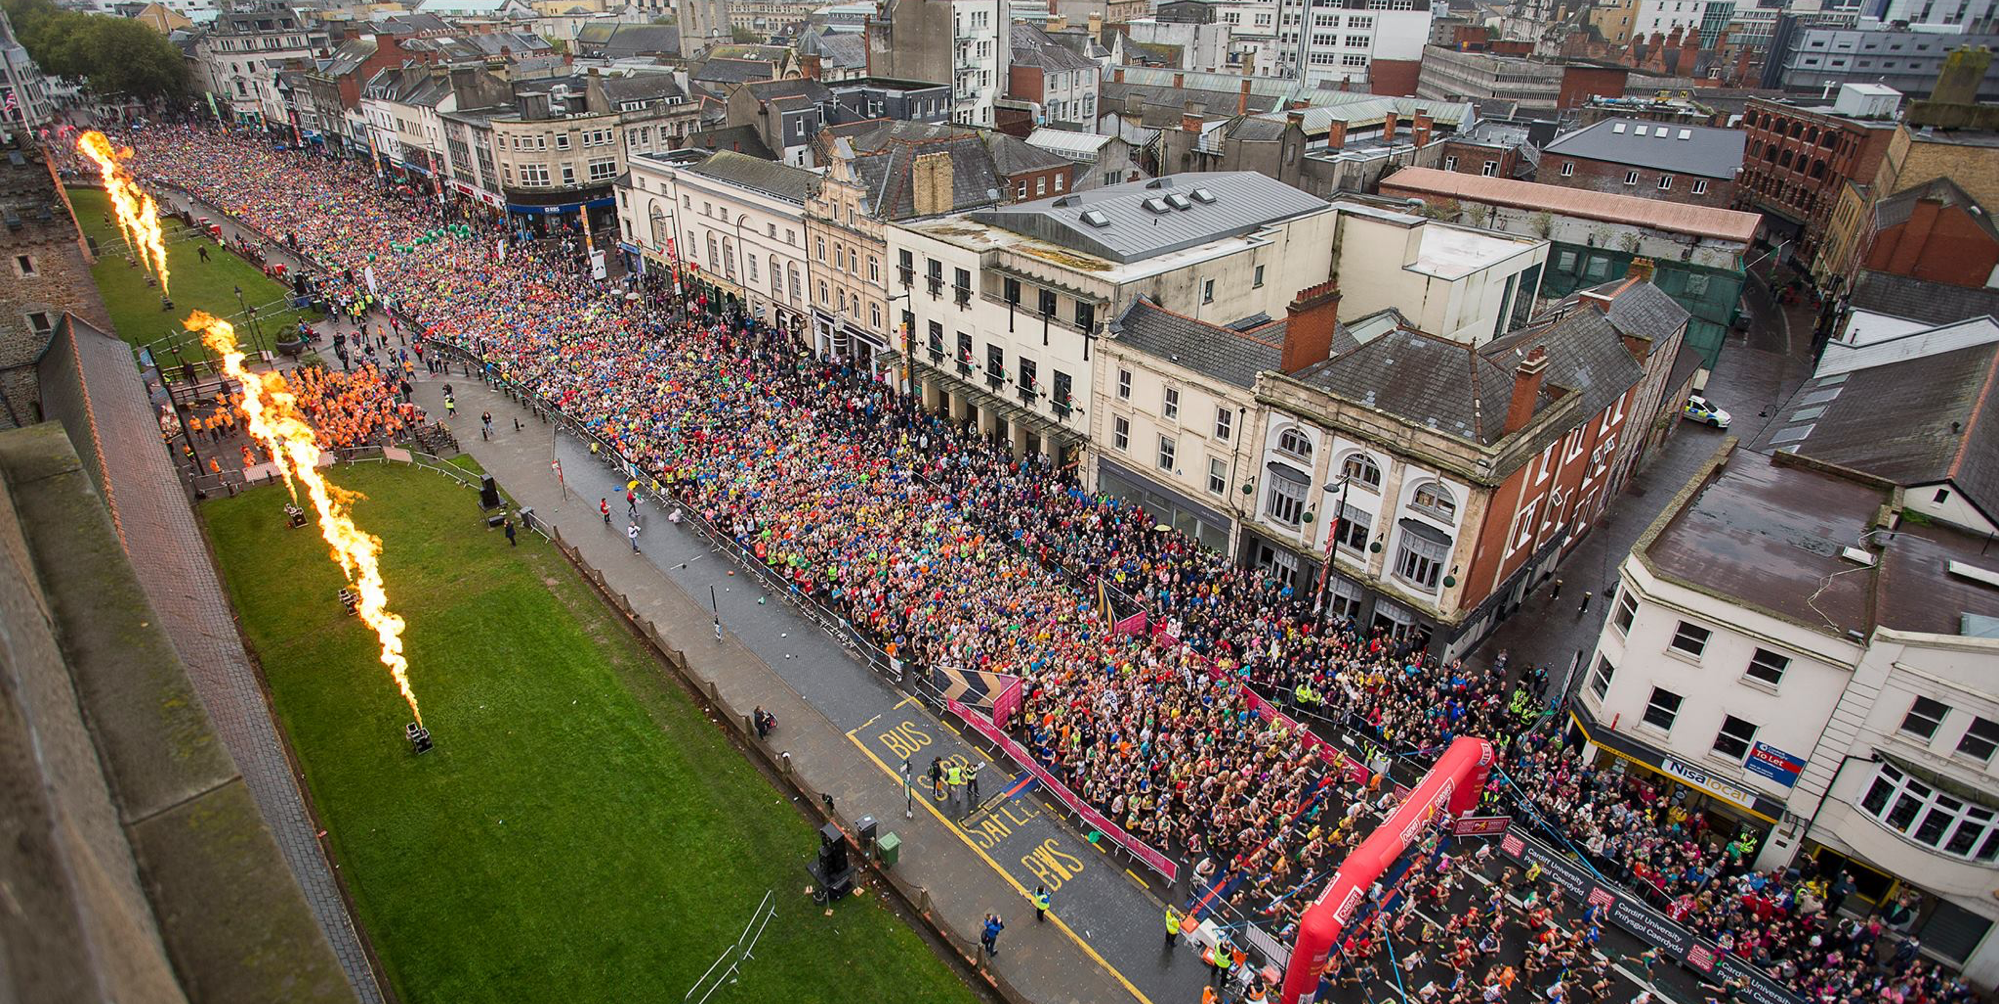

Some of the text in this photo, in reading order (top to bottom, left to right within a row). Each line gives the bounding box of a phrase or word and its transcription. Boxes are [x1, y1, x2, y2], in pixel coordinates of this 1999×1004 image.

[879, 721, 932, 760] BUS
[1756, 749, 1767, 760] To
[1769, 756, 1784, 766] Let
[1021, 838, 1084, 891] BWS
[1528, 848, 1584, 886] Cardiff University
[1552, 872, 1584, 896] Caerdydd
[1339, 892, 1360, 918] CARDIFF
[1618, 902, 1682, 943] Cardiff University
[1614, 910, 1684, 954] Prifysgol Caerdydd
